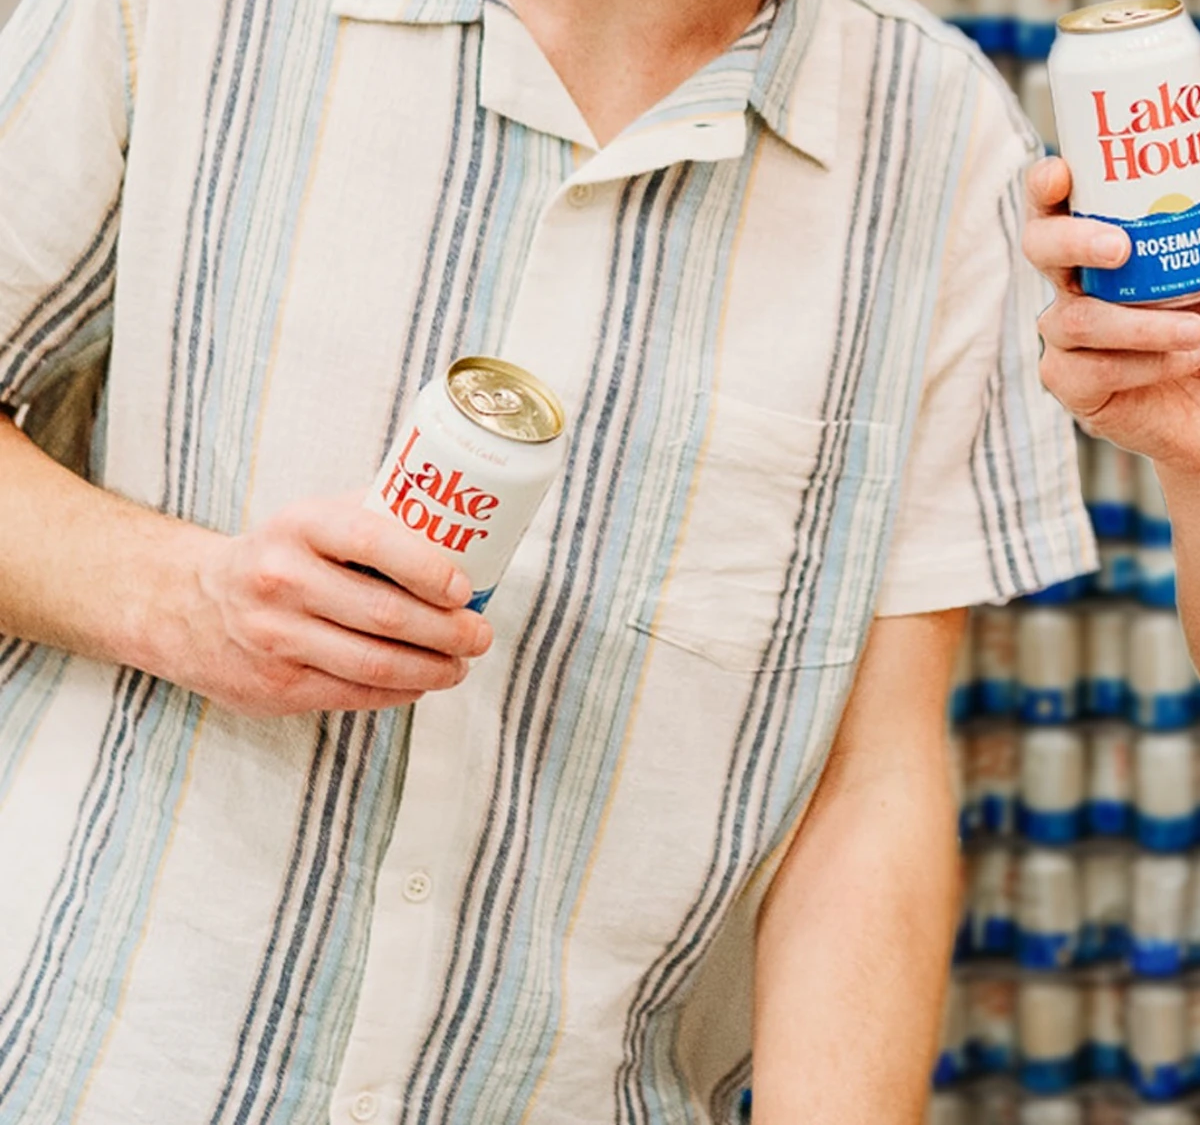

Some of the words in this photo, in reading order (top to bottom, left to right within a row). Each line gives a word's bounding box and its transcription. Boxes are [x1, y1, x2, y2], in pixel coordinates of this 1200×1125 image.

[1158, 250, 1200, 272] YUZU
[381, 463, 488, 553] Hour
[399, 426, 499, 521] Lake
